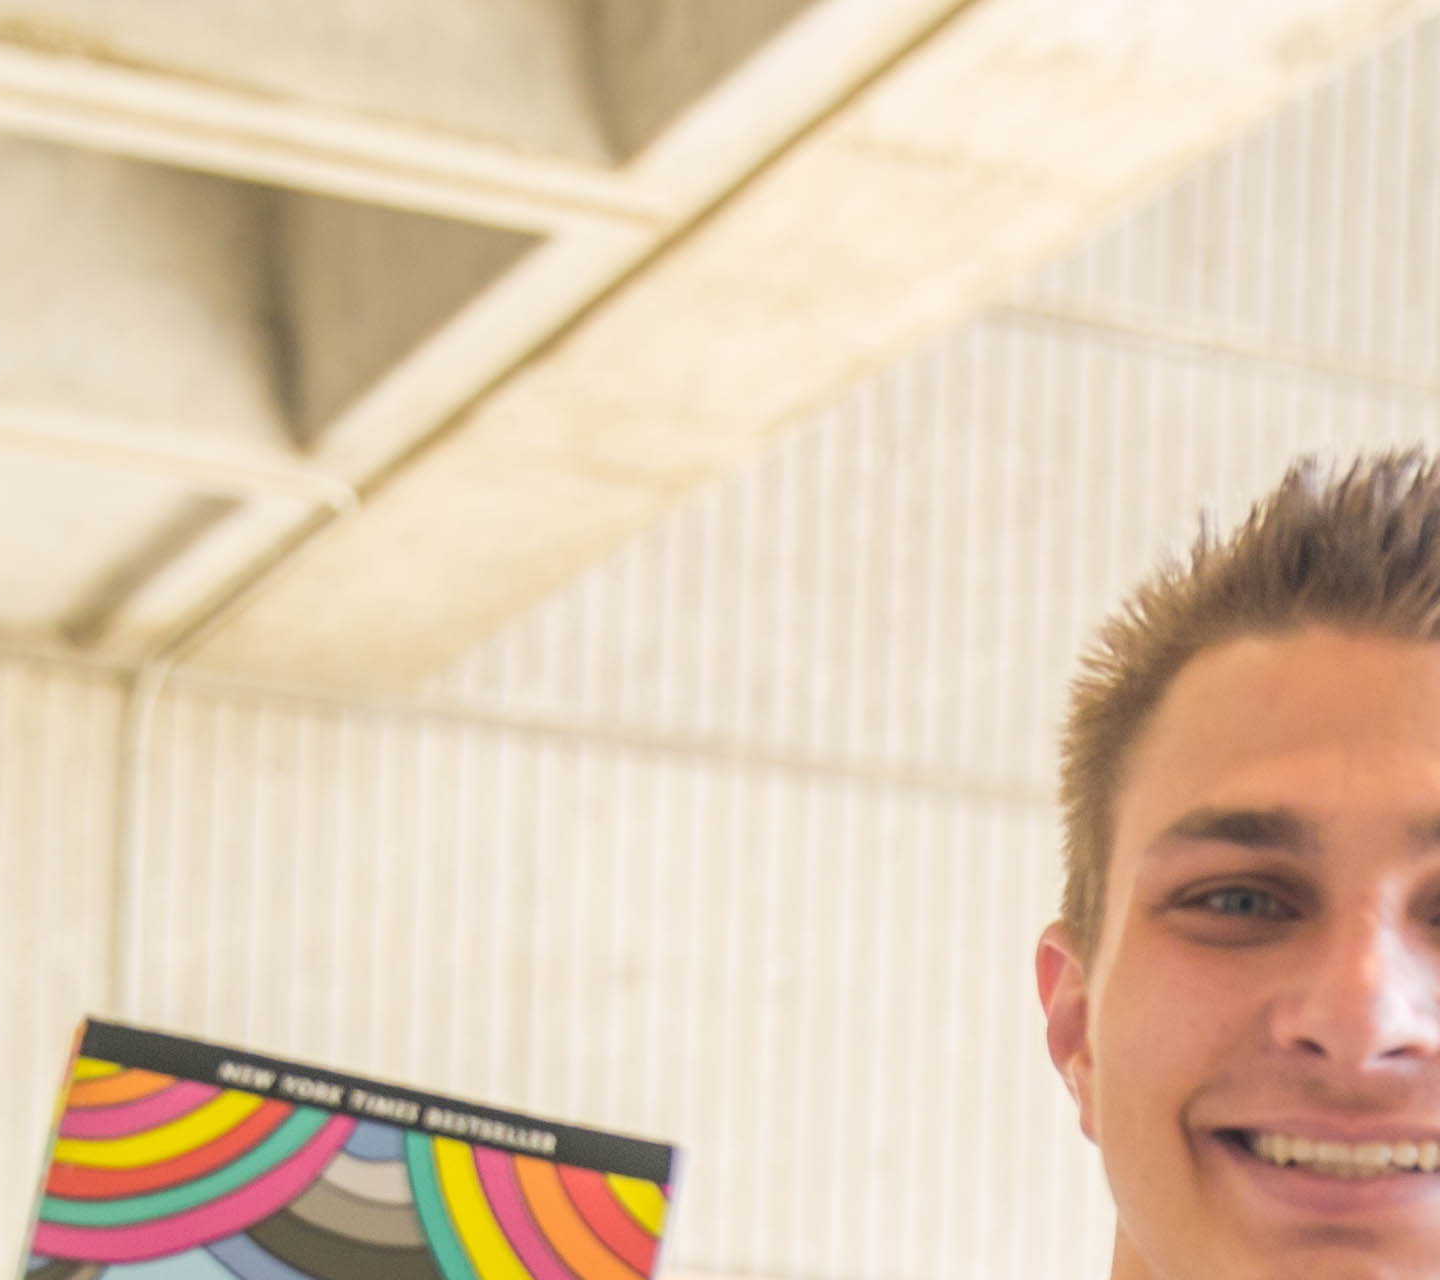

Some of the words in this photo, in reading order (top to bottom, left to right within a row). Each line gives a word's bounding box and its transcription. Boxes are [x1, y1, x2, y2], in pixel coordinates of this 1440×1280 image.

[217, 1059, 277, 1090] NEW
[279, 1073, 344, 1105] YORK
[347, 1087, 421, 1124] TIMES
[422, 1106, 557, 1154] BESTSELLER
